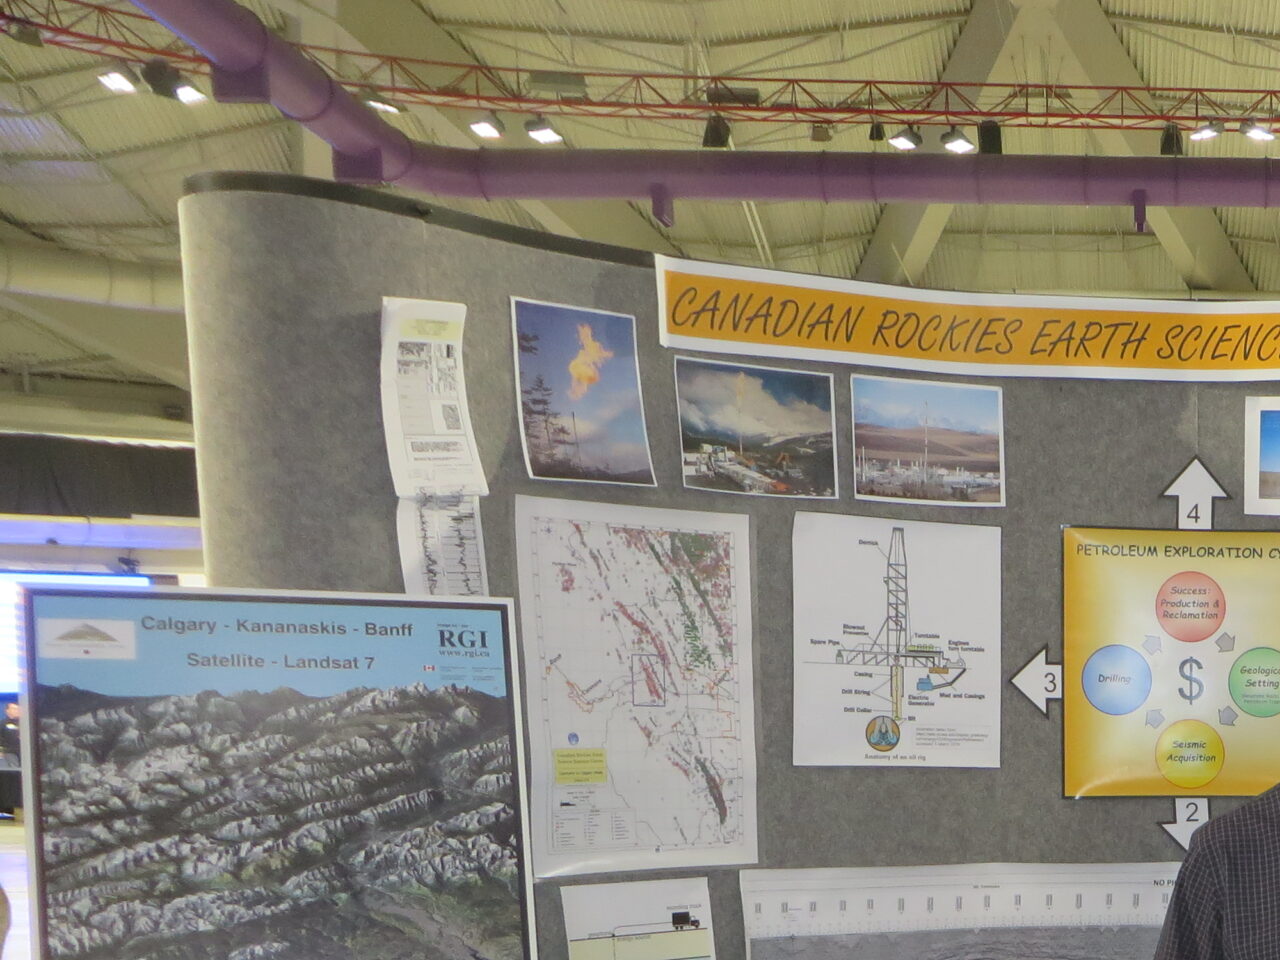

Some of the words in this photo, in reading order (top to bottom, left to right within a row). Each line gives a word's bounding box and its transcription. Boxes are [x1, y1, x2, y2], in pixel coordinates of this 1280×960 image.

[671, 286, 865, 343] CANADIAN
[872, 309, 1023, 355] ROCKIES
[1030, 319, 1151, 360] EARTH
[1186, 503, 1201, 524] 4
[1076, 543, 1159, 558] PETROLEUM
[1164, 545, 1264, 560] EXPLORATION
[1170, 585, 1211, 596] Success:
[1160, 598, 1210, 610] Production
[1162, 611, 1219, 621] Reclamation
[140, 616, 217, 635] Calgary
[236, 619, 347, 636] Kananaskis
[364, 622, 414, 637] Banff
[438, 629, 489, 649] RGI
[187, 653, 265, 668] Satellite
[284, 656, 359, 670] Landsat
[364, 657, 375, 670] 7
[1044, 672, 1056, 693] 3
[1097, 673, 1131, 684] Drilling
[1245, 679, 1280, 690] Setting
[1172, 739, 1207, 750] Seismic
[1167, 753, 1216, 765] Acquisition
[1186, 802, 1199, 822] 2
[1153, 879, 1165, 887] NO
[1167, 879, 1175, 887] PI
